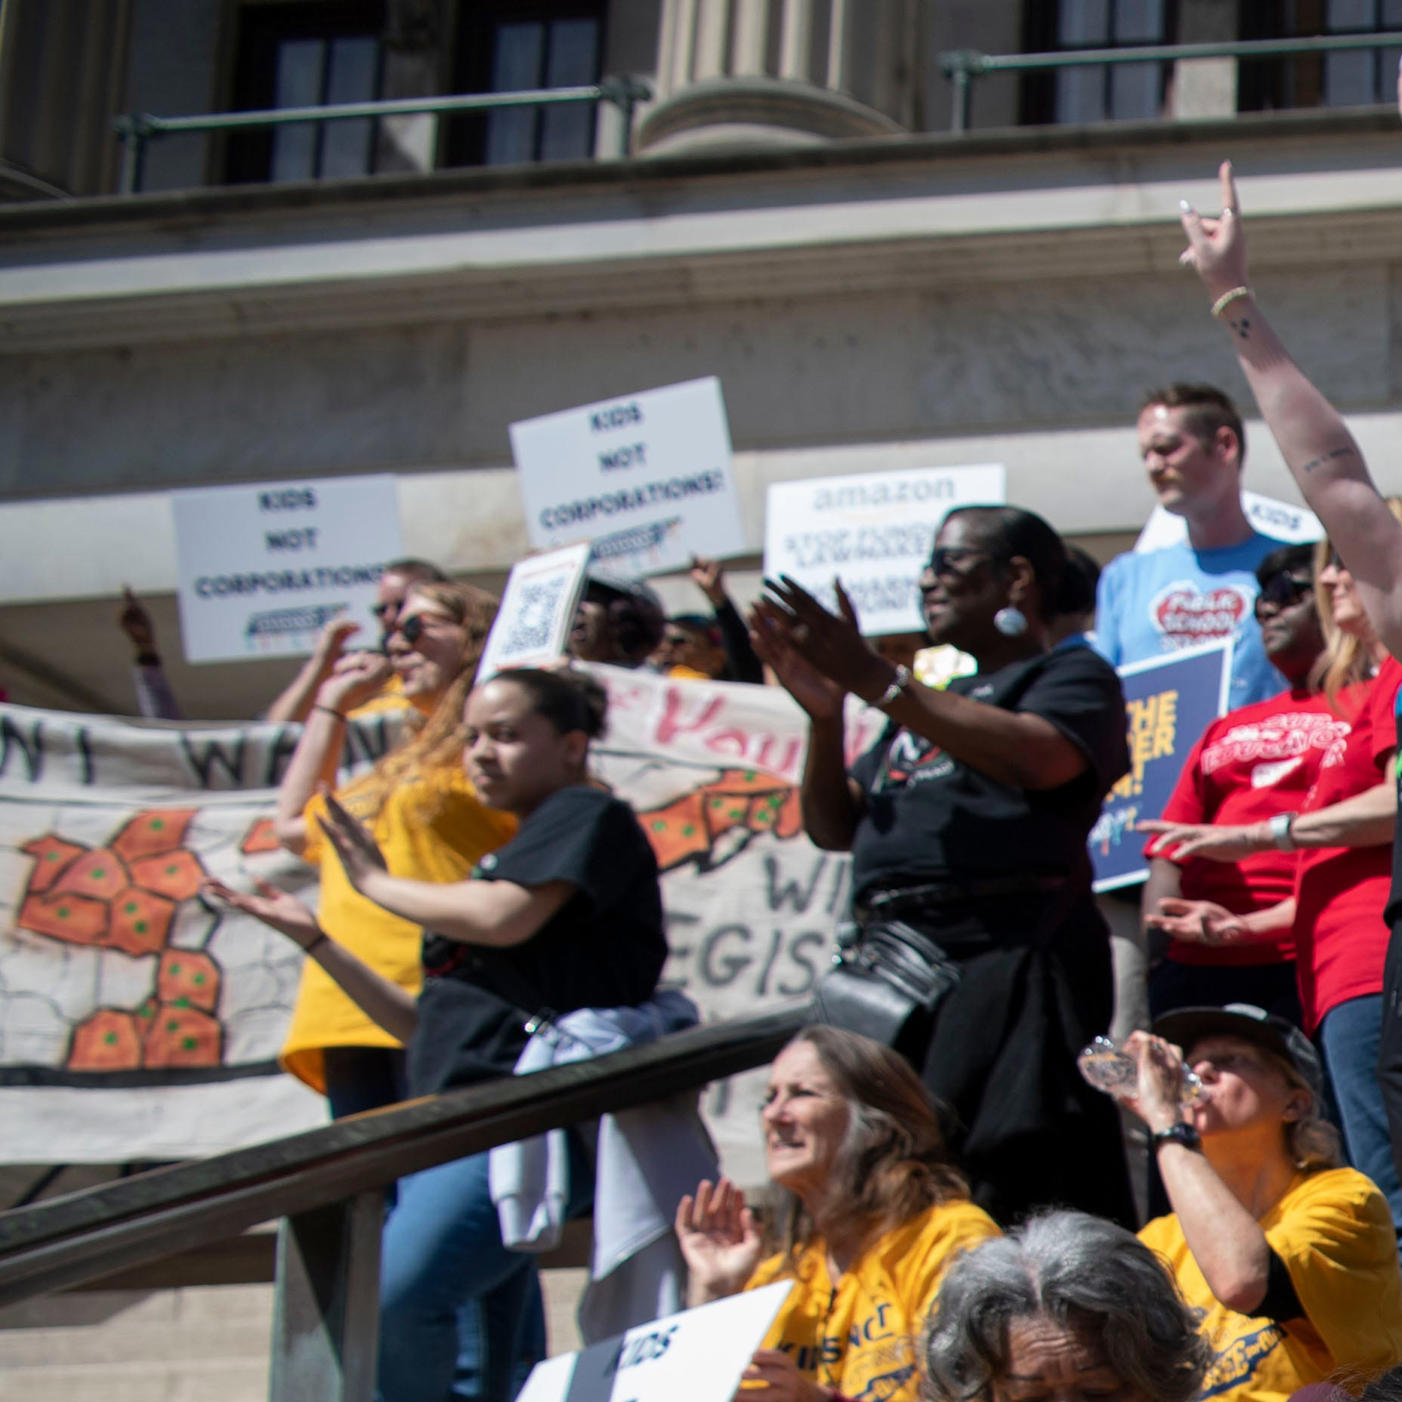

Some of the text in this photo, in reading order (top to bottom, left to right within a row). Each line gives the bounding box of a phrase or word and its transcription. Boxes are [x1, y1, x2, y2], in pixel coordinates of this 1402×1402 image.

[589, 401, 641, 431] KIDS
[598, 442, 646, 470] NOT
[257, 487, 318, 512] KIDS
[539, 468, 724, 530] CORPORATIONS!
[813, 478, 955, 511] amazon
[1251, 501, 1303, 531] KIDS
[264, 526, 320, 550] NOT
[1126, 690, 1178, 730] HE
[605, 1324, 679, 1378] KIDS
